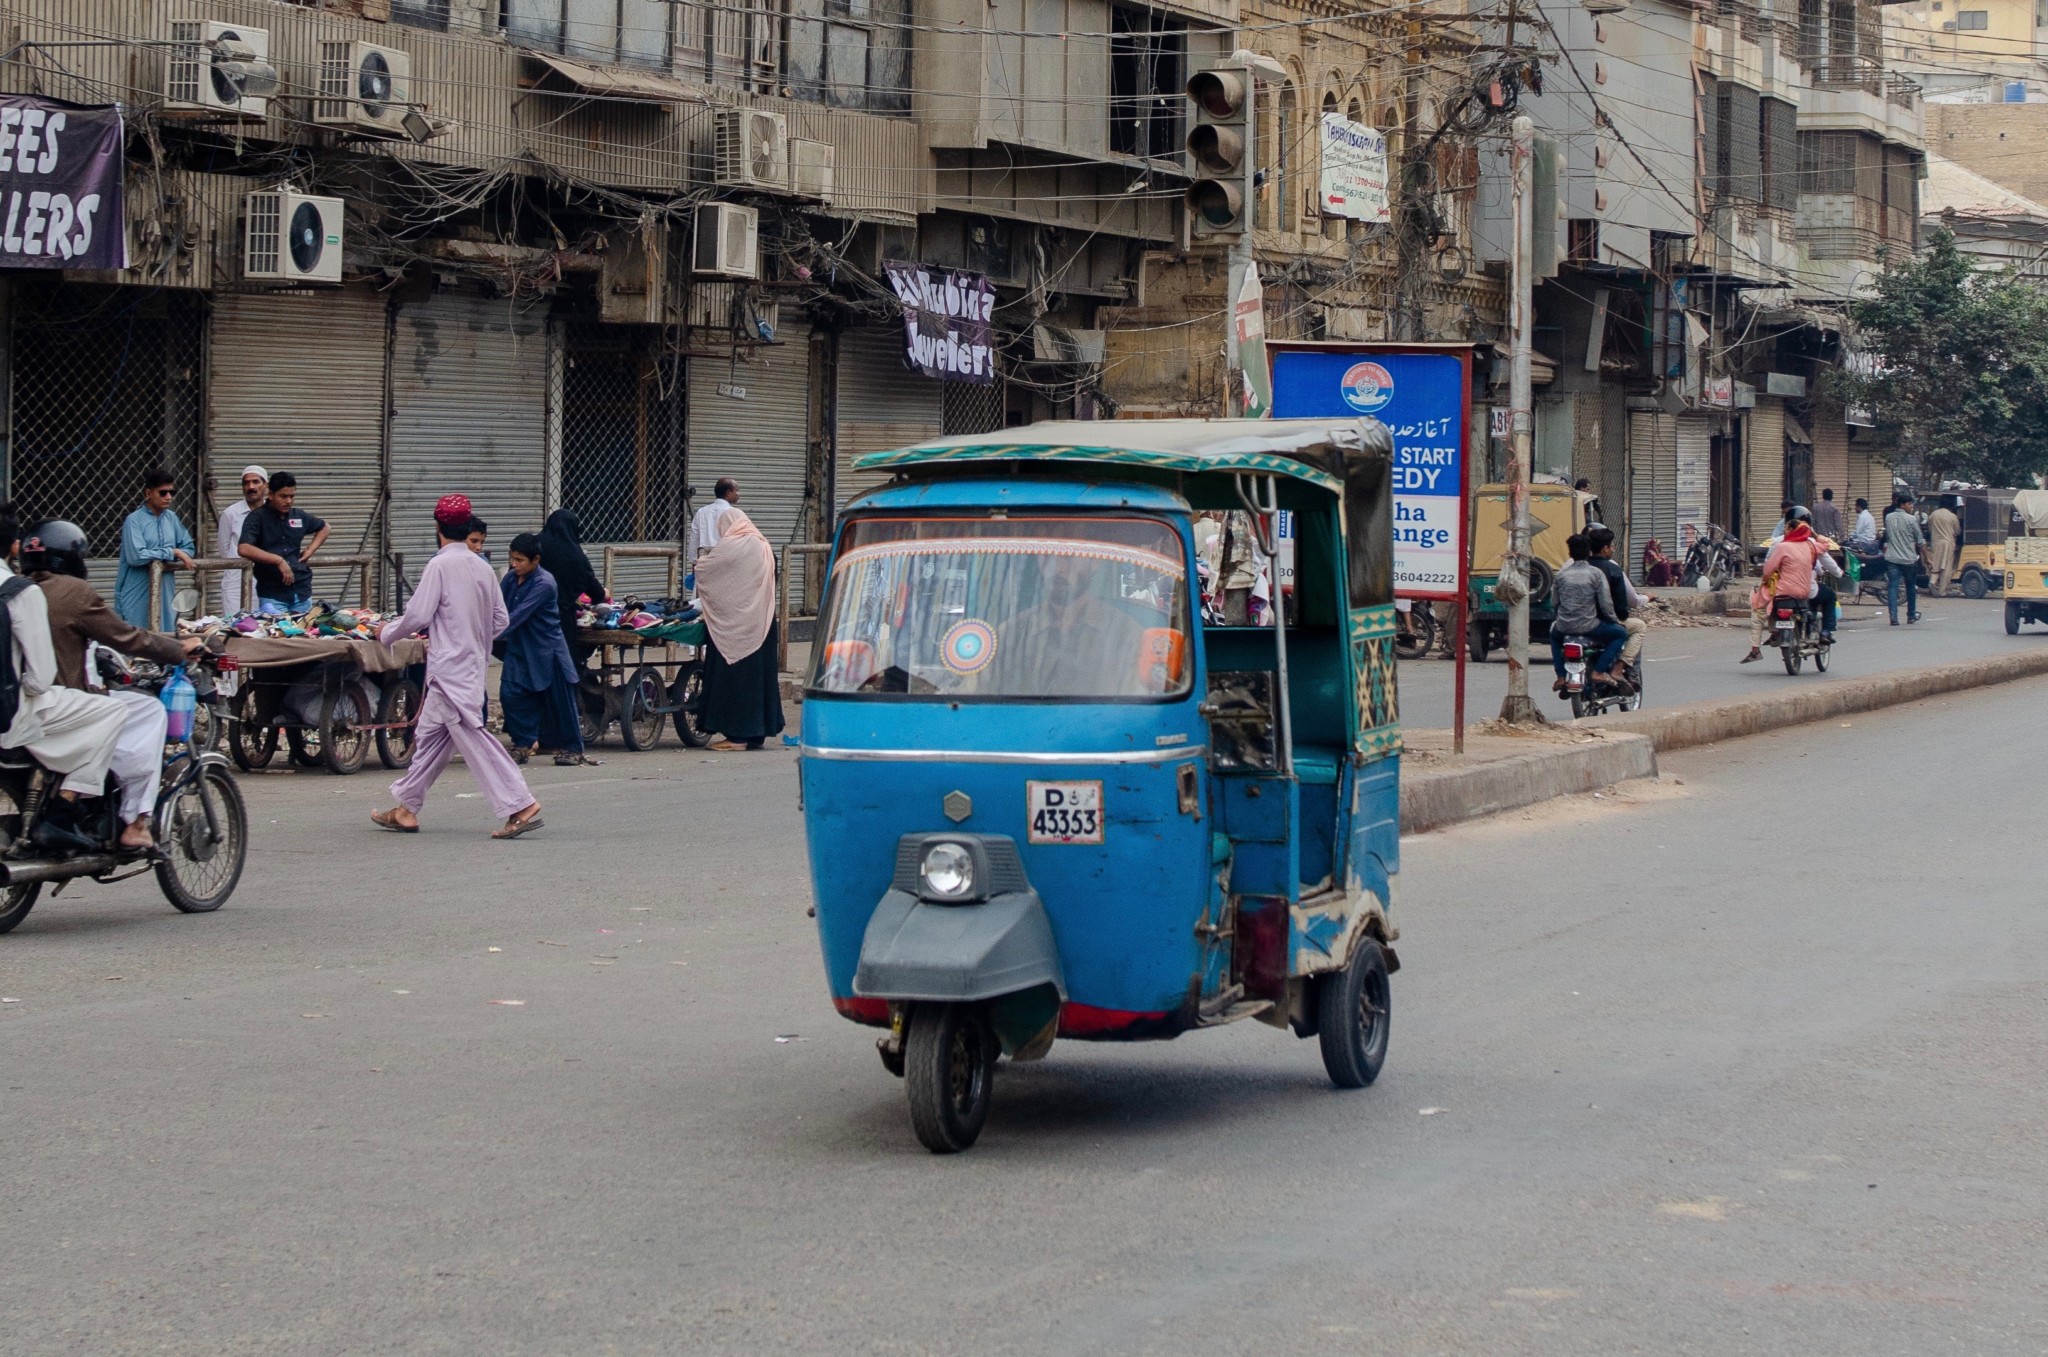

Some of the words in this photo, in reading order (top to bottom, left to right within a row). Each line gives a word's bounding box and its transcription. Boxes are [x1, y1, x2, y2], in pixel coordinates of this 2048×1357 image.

[916, 269, 996, 322] Rubina
[1400, 446, 1456, 466] START
[1394, 501, 1427, 521] ha
[1045, 789, 1064, 807] D
[1033, 809, 1096, 835] 43353
